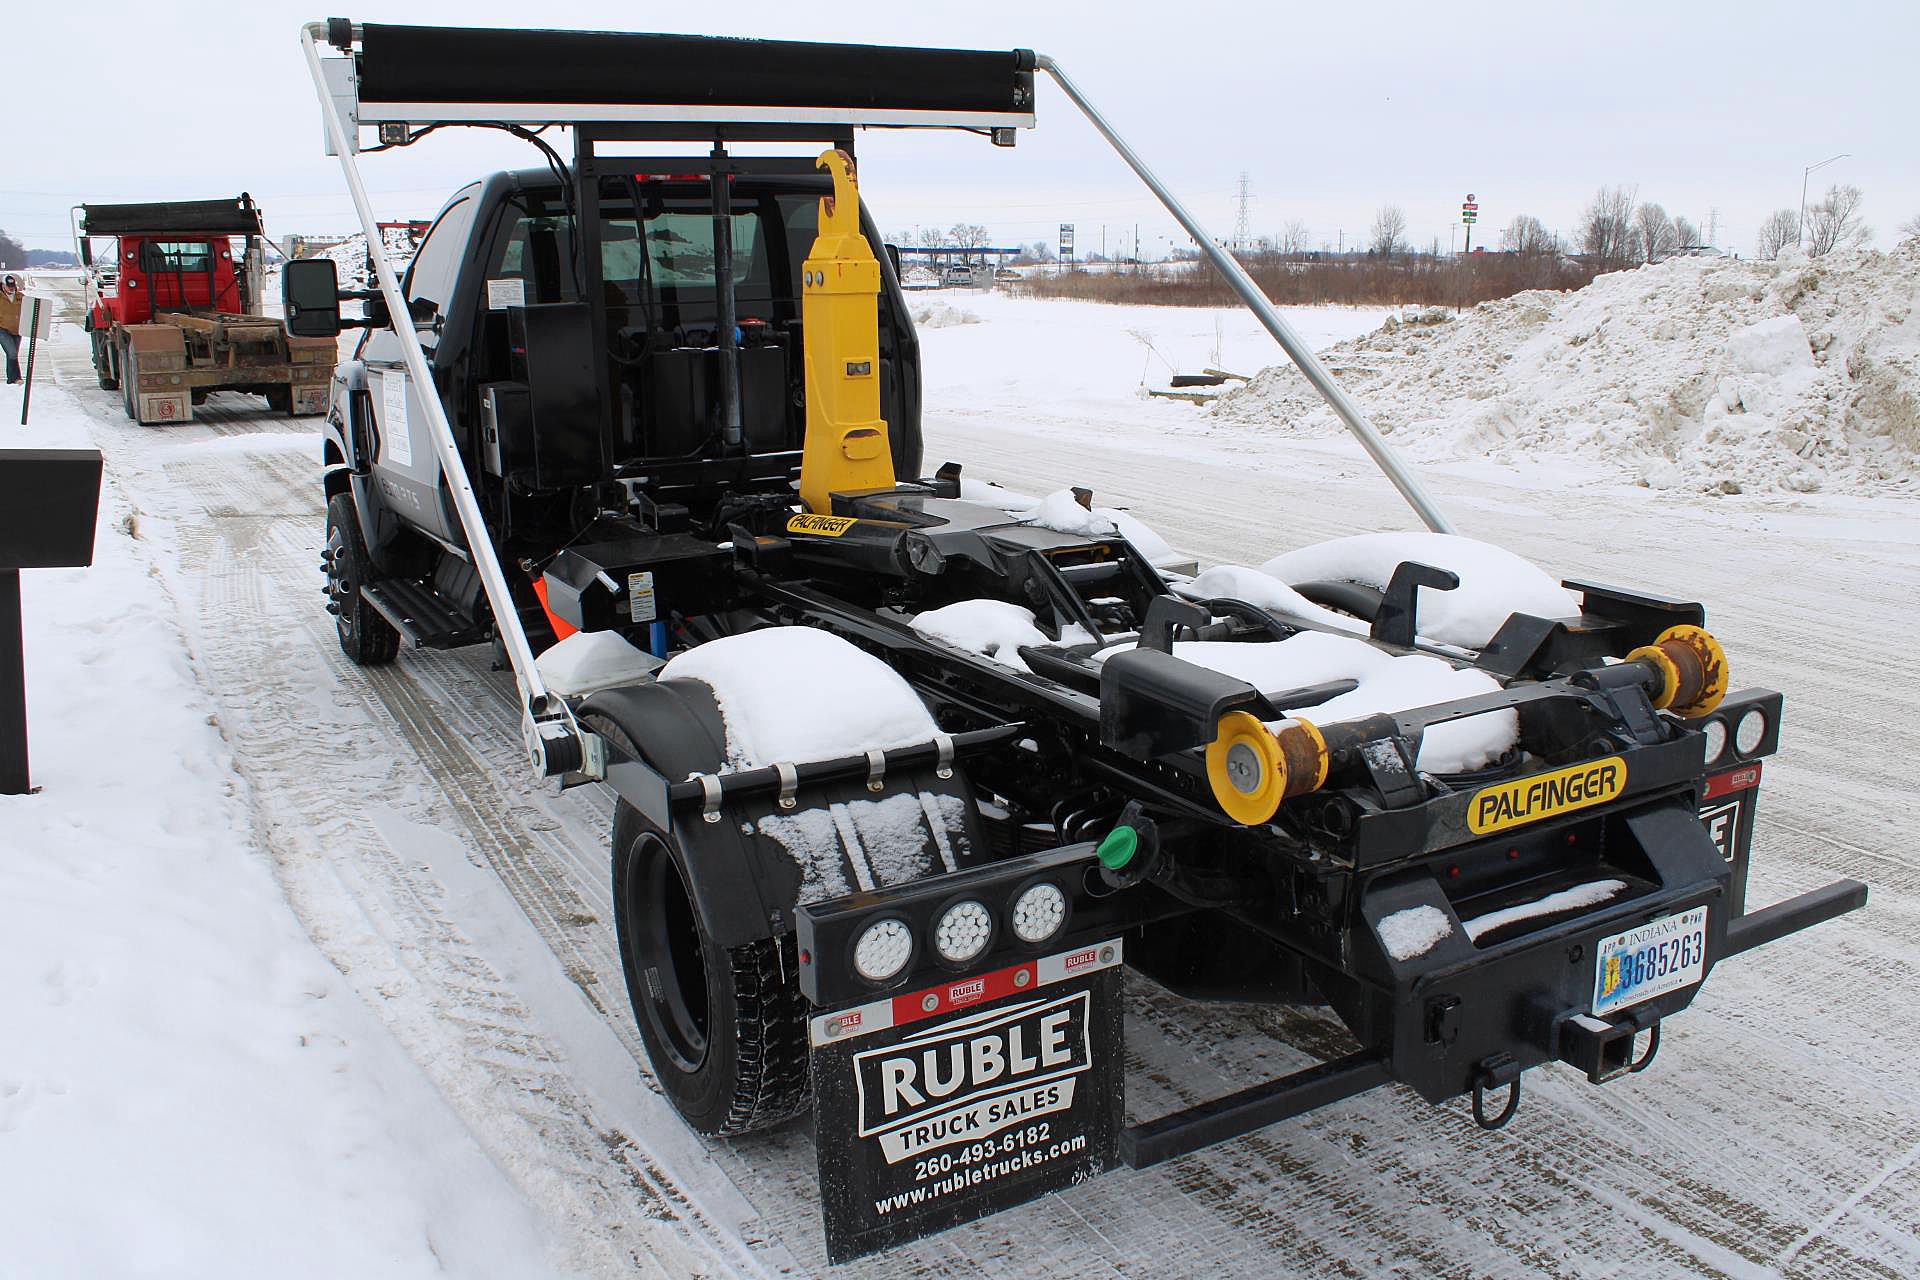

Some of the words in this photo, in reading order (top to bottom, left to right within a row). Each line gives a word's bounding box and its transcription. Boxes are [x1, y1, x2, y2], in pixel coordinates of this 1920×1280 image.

[790, 515, 852, 532] PALFINGER
[1478, 765, 1616, 827] PALFINGER
[1067, 952, 1095, 967] RUBLE
[1622, 931, 1702, 989] 3685263
[1629, 920, 1677, 946] INDIANA
[952, 983, 982, 997] RUBLE
[881, 1010, 1072, 1115] RUBLE
[900, 1110, 979, 1151] TRUCK
[988, 1086, 1059, 1123] SALES
[875, 1134, 1086, 1215] www.rubletrucks.com
[914, 1122, 1050, 1181] 260-493-6182
